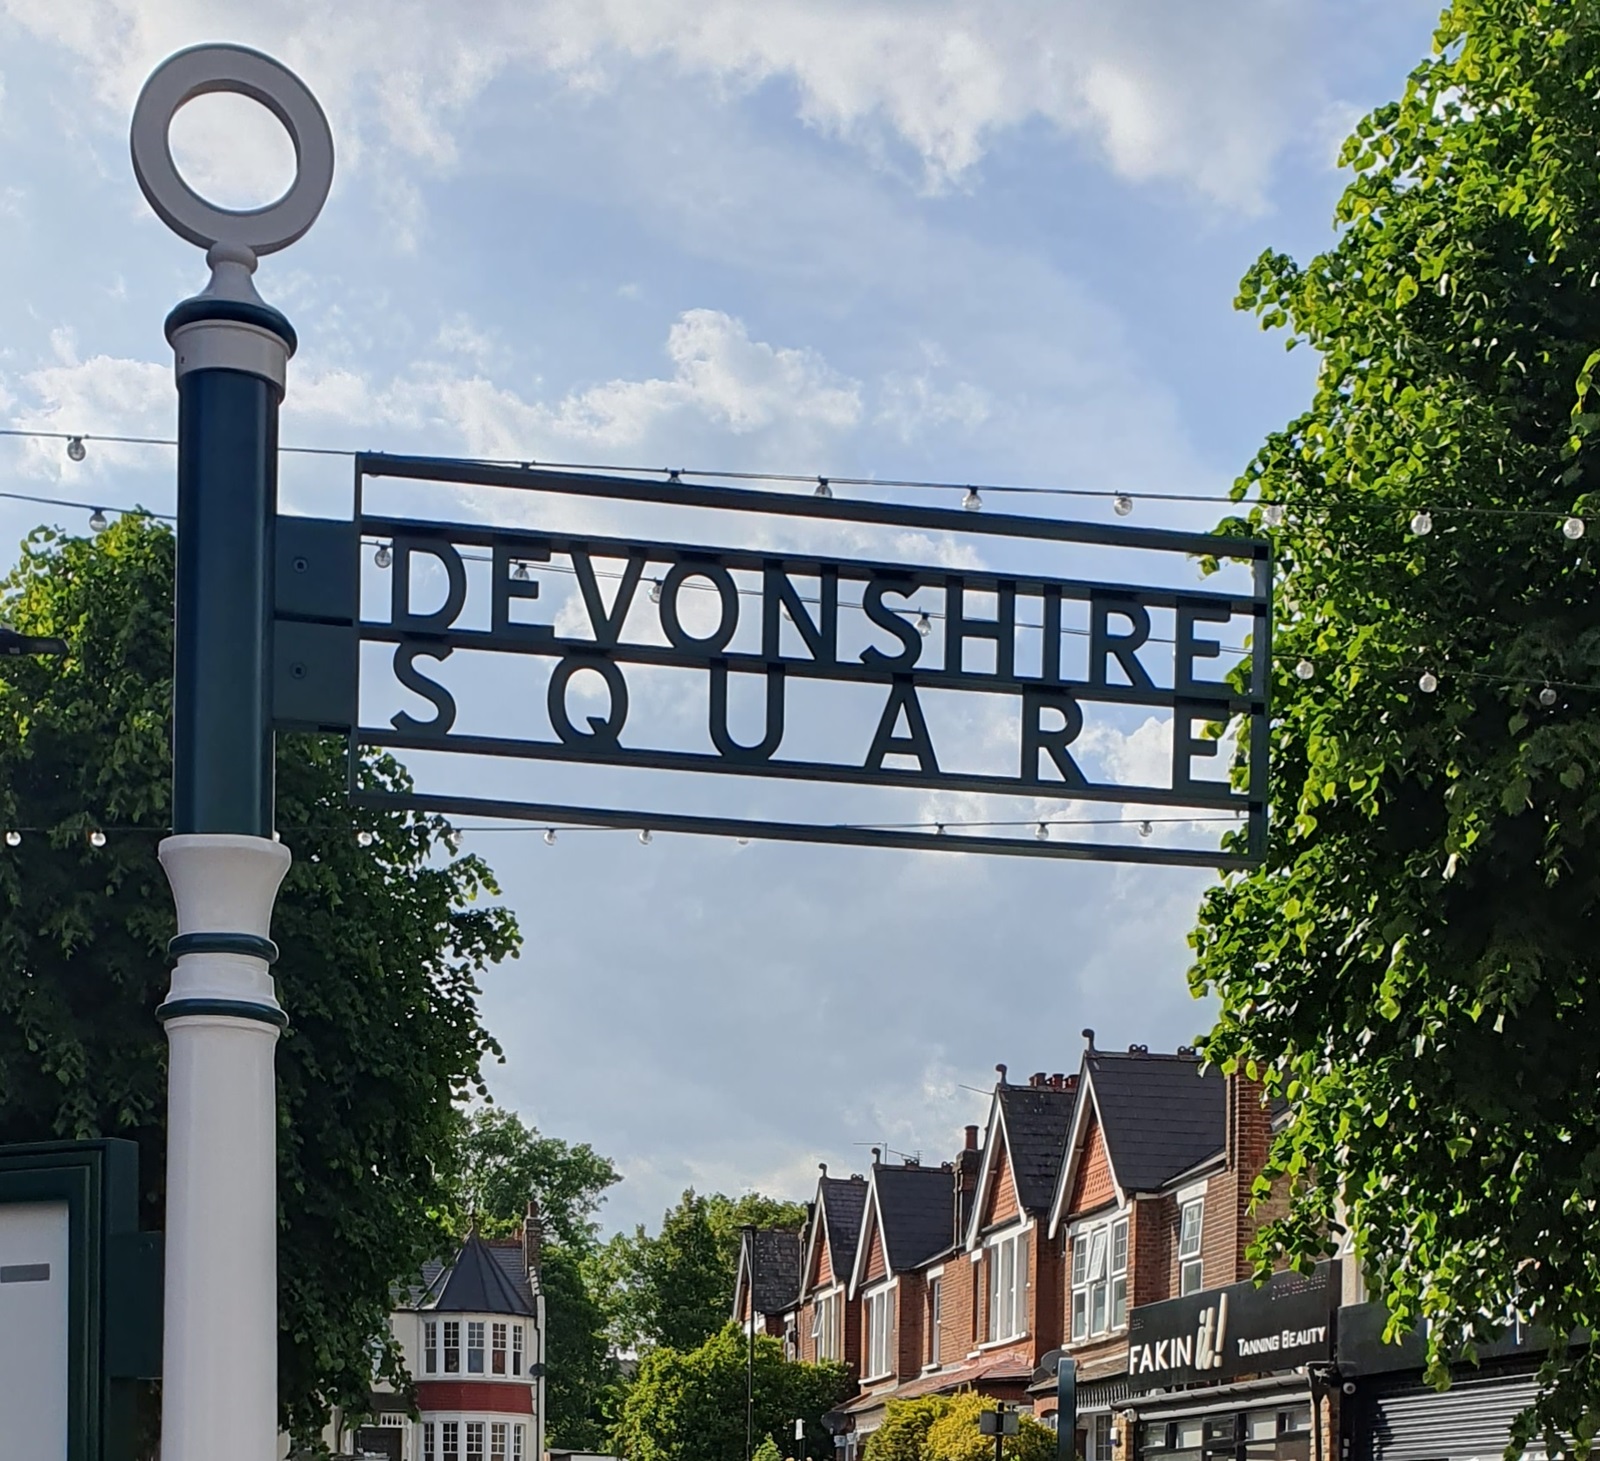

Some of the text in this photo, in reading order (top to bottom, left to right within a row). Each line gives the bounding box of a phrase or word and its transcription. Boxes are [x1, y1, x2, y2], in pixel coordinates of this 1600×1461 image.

[391, 534, 1234, 692] DEVONSHIRE
[390, 635, 1232, 797] SQUARE
[1129, 1334, 1192, 1375] FAKIN
[1237, 1326, 1326, 1356] TANNING BEAUTY
